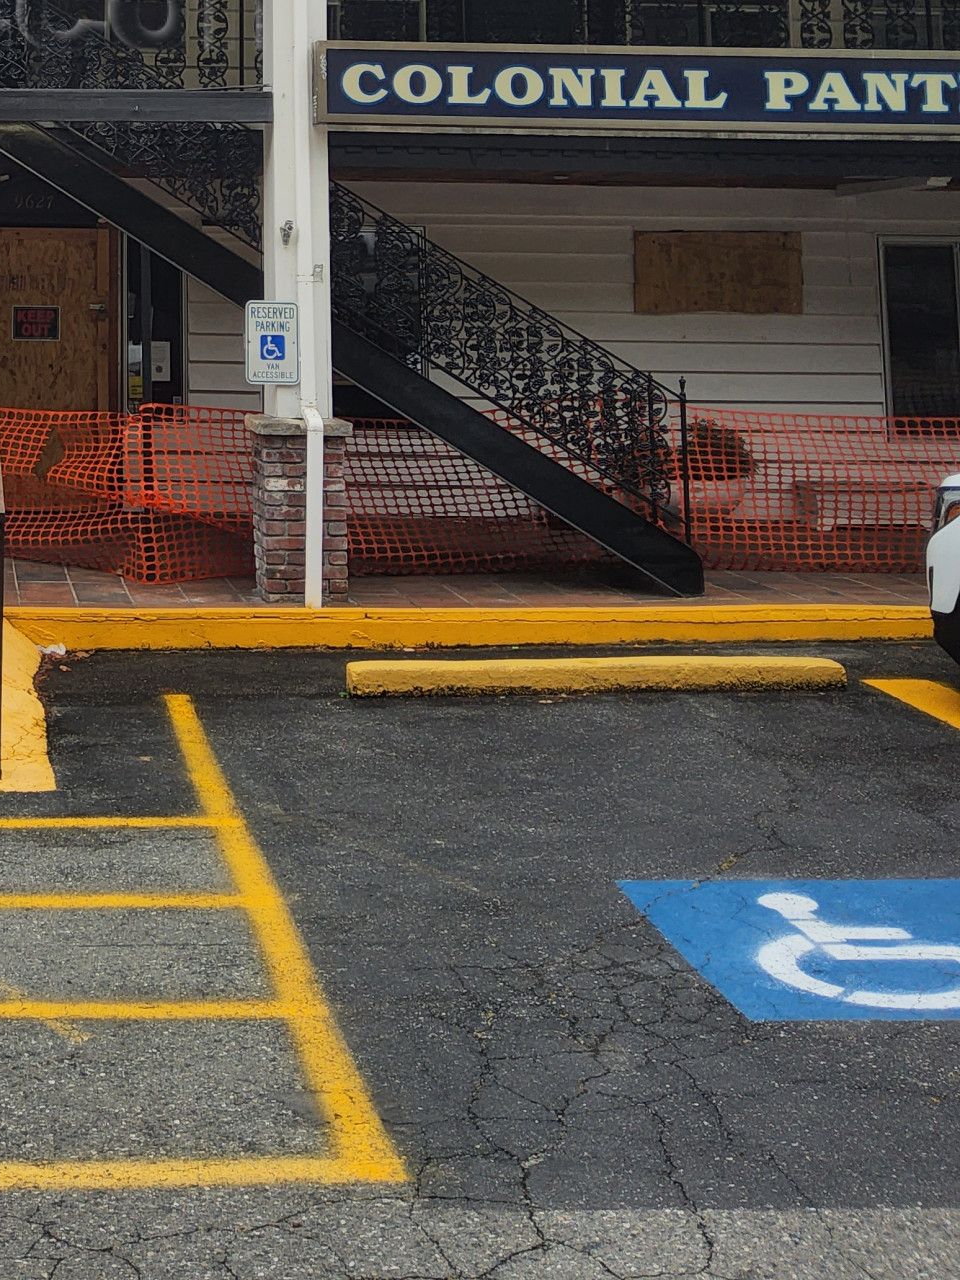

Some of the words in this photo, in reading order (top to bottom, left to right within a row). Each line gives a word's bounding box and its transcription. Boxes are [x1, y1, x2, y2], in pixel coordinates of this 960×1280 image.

[340, 62, 729, 110] COLONIAL
[763, 70, 960, 112] PANT
[17, 310, 54, 322] KEEP
[250, 306, 295, 319] RESERVED
[22, 324, 49, 336] OUT
[255, 320, 290, 332] PARKING
[266, 362, 280, 370] VAN
[252, 371, 294, 379] ACCESSIBLE
